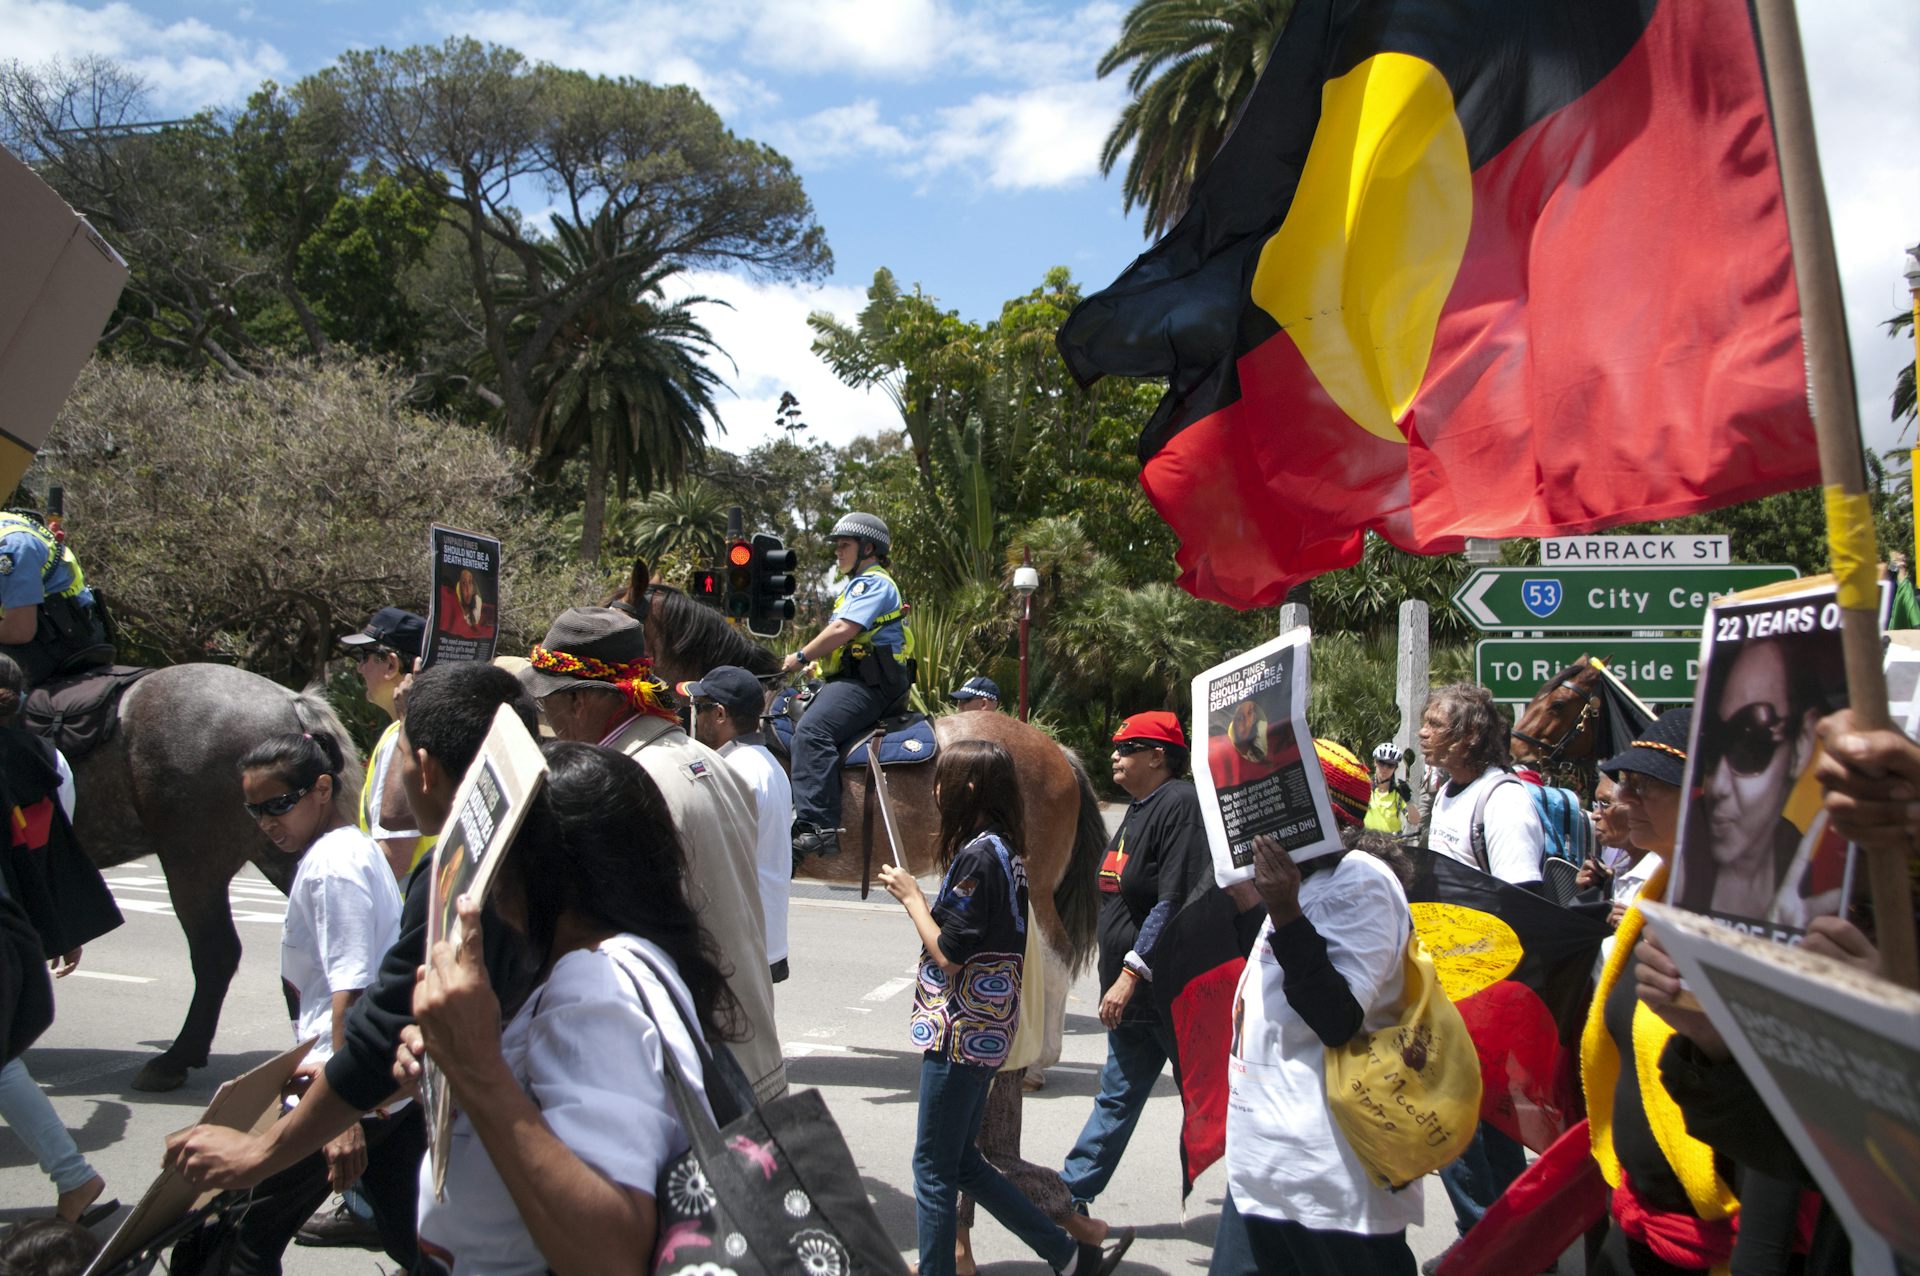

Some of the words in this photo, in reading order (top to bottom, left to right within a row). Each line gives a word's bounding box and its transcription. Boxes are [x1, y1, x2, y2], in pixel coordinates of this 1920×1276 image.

[444, 544, 466, 557] SHOULD
[466, 549, 476, 559] NOT
[477, 552, 484, 561] BE
[444, 554, 462, 565] DEATH
[462, 558, 488, 571] SENTENCE
[1546, 541, 1676, 560] BARRACK
[1693, 541, 1723, 559] ST
[1529, 585, 1556, 606] 53
[1587, 588, 1649, 614] City
[1716, 616, 1740, 642] 22
[1745, 606, 1816, 638] YEARS
[1820, 602, 1844, 630] O
[1210, 680, 1244, 702] SHOULD
[1245, 672, 1263, 688] NOT
[1264, 666, 1276, 678] BE
[1277, 663, 1284, 673] A
[1211, 672, 1240, 692] UNPAID
[1242, 660, 1266, 679] FINES
[1490, 661, 1522, 680] TO
[1210, 693, 1238, 712] DEATH
[1238, 674, 1282, 700] SENTENCE
[1233, 840, 1252, 855] JUST
[1279, 824, 1298, 839] MISS
[1298, 817, 1317, 832] DHU
